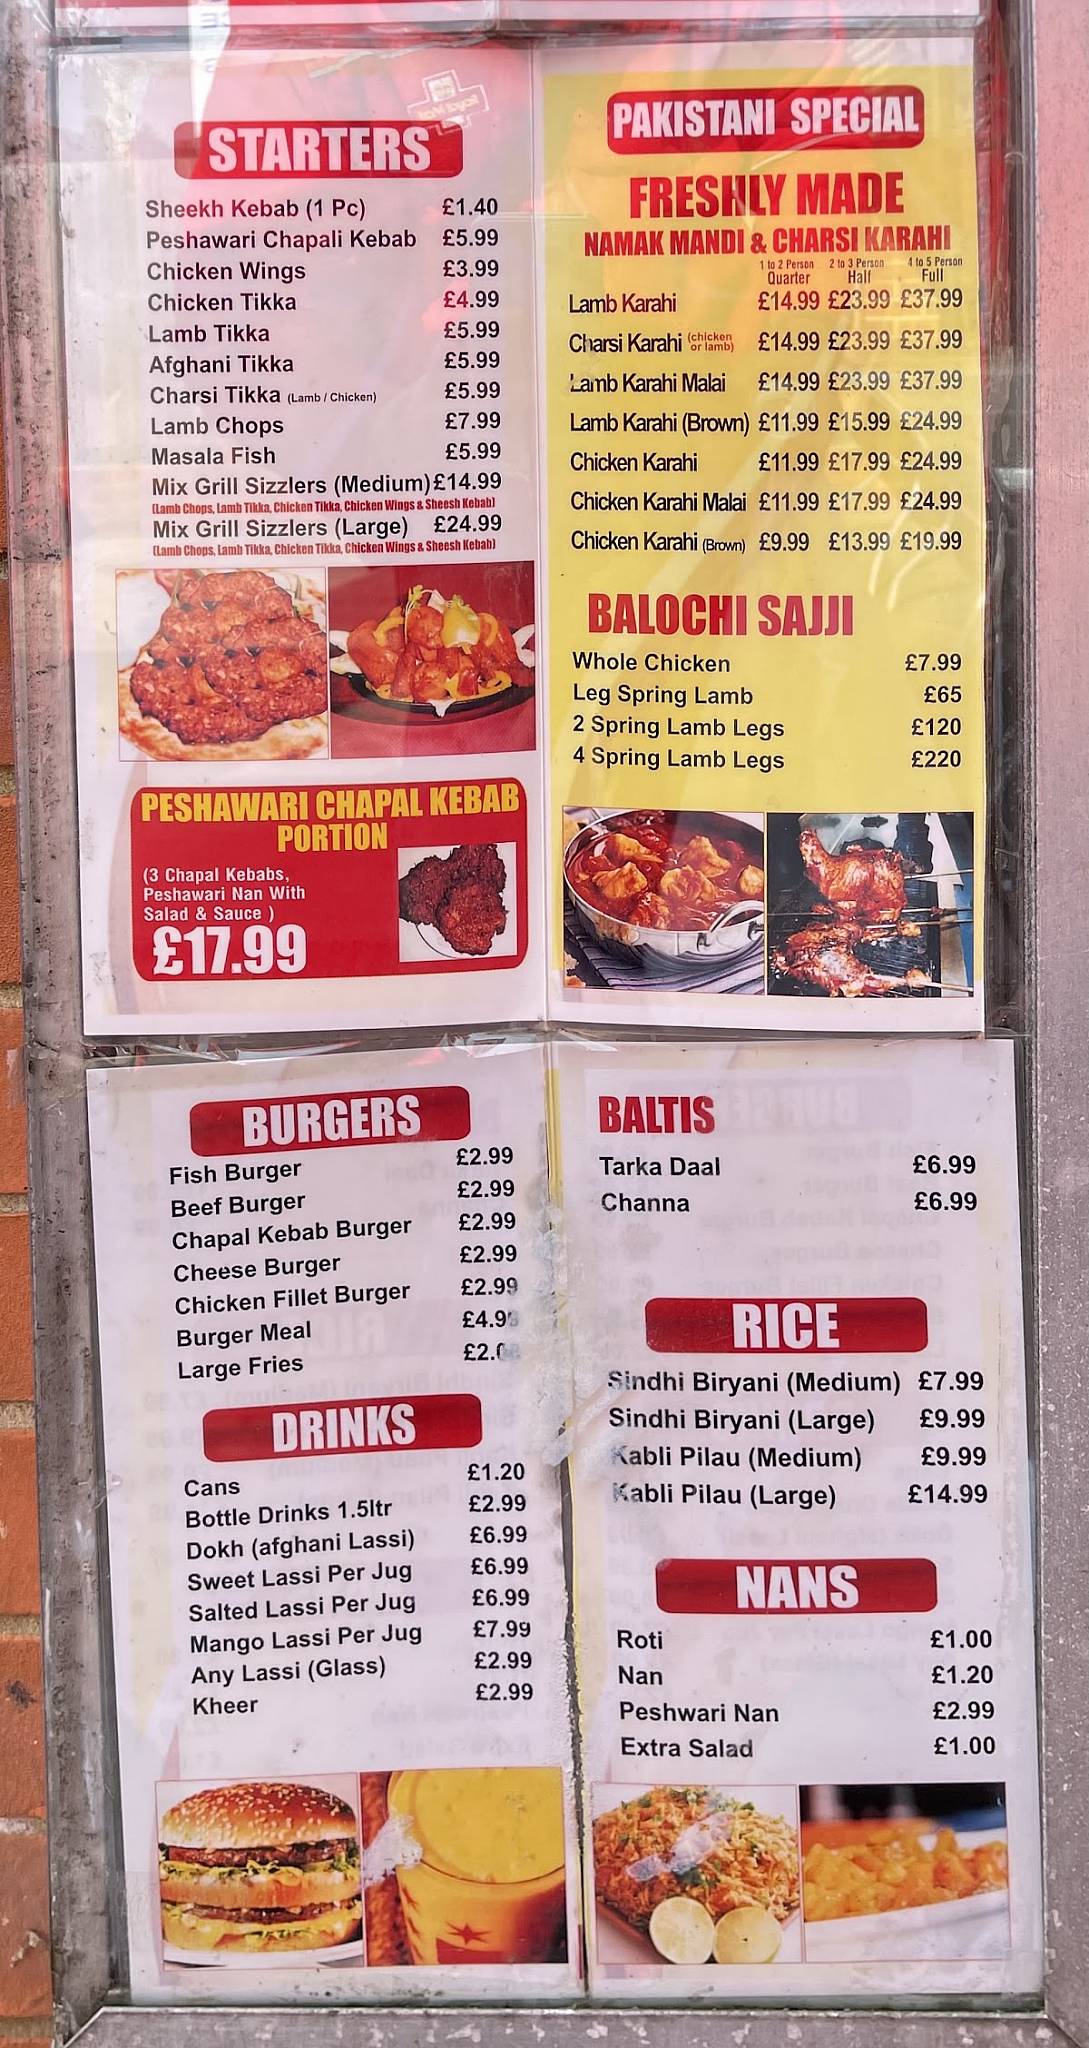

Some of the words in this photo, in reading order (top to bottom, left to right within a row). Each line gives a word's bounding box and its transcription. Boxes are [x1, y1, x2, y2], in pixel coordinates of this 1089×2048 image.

[614, 99, 775, 139] PAKISTANI
[791, 96, 919, 135] SPECIAL
[209, 127, 433, 172] STARTERS
[630, 174, 787, 219] FRESHLY
[797, 172, 904, 215] MADE
[146, 200, 224, 218] Sheekh
[232, 200, 299, 218] Kebab
[307, 199, 322, 221] (1
[333, 199, 365, 221] Pc)
[442, 198, 498, 216] £1.40
[148, 231, 256, 249] Peshawari
[264, 230, 342, 253] Chapali
[351, 230, 416, 248] Kebab
[443, 229, 498, 247] £5.99
[585, 231, 664, 257] NAMAK
[670, 229, 744, 255] MANDI
[751, 233, 767, 254] &
[773, 227, 858, 254] CHARSI
[865, 226, 950, 252] KARAHI
[148, 262, 233, 280] Chicken
[240, 262, 306, 284] Wings
[443, 260, 499, 278] £3.99
[760, 260, 764, 270] 1
[768, 260, 776, 270] to
[778, 260, 783, 270] 2
[787, 260, 814, 270] Person
[830, 259, 835, 269] 2
[838, 259, 845, 269] to
[848, 258, 853, 268] 3
[856, 258, 884, 268] Person
[908, 257, 913, 267] 4
[916, 258, 924, 267] to
[927, 257, 932, 267] 5
[935, 257, 963, 267] Person
[768, 272, 810, 286] Quarter
[848, 270, 871, 284] Half
[922, 268, 943, 282] Full
[148, 294, 233, 312] Chicken
[240, 293, 296, 311] Tikka
[444, 291, 499, 308] £4.99
[570, 294, 618, 314] Lamb
[623, 293, 676, 313] Karahi
[758, 291, 820, 311] £14.99
[828, 290, 890, 310] £23.99
[901, 288, 963, 309] £37.99
[570, 334, 623, 353] Charsi
[628, 333, 682, 353] Karahi
[688, 332, 733, 344] (chicken
[705, 342, 734, 353] lamb)
[758, 332, 820, 352] £14.99
[828, 331, 890, 351] £23.99
[901, 330, 963, 350] £37.99
[150, 356, 231, 378] Afghani
[238, 355, 294, 373] Tikka
[445, 351, 500, 369] £5.99
[151, 386, 217, 404] Charsi
[225, 386, 281, 404] Tikka
[288, 393, 321, 405] (Lamb
[324, 393, 328, 403] /
[330, 392, 377, 404] Chicken)
[445, 382, 501, 400] £5.99
[152, 448, 224, 465] Masala
[232, 447, 276, 464] Fish
[446, 442, 501, 460] £5.99
[153, 478, 188, 496] Mix
[196, 478, 238, 495] Grill
[246, 477, 327, 495] Sizzlers
[335, 474, 430, 498] (Medium)
[434, 472, 502, 491] £14.99
[153, 504, 181, 514] (Lamb
[183, 504, 215, 515] Chops,
[217, 503, 242, 514] Lamb
[244, 503, 272, 513] Tikka,
[274, 502, 313, 513] Chicken
[315, 501, 343, 513] Tikka,
[345, 501, 383, 512] Chicken
[385, 500, 415, 512] Wings
[417, 501, 424, 510] &
[426, 499, 461, 510] Sheesh
[463, 497, 495, 509] Kebab)
[589, 594, 747, 636] BALOCHI
[758, 595, 853, 636] SAJJI
[573, 652, 637, 671] Whole
[645, 654, 730, 673] Chicken
[906, 654, 962, 671] £7.99
[574, 684, 610, 706] Leg
[618, 685, 687, 708] Spring
[696, 687, 753, 705] Lamb
[924, 686, 962, 704] £65
[142, 792, 308, 822] PESHAWARI
[317, 788, 423, 820] CHAPAL
[430, 784, 520, 816] KEBAB
[278, 823, 388, 852] PORTION
[144, 868, 159, 885] (3
[166, 868, 219, 885] Chapal
[227, 867, 289, 883] Kebabs,
[144, 887, 225, 902] Peshawari
[233, 887, 263, 901] Nan
[269, 886, 305, 900] With
[144, 907, 188, 922] Salad
[196, 907, 207, 921] &
[214, 907, 261, 921] Sauce
[154, 925, 306, 976] £17.99
[244, 1095, 421, 1147] BURGERS
[599, 1096, 715, 1134] BALTIS
[170, 1166, 217, 1185] Fish
[226, 1163, 302, 1183] Burger
[456, 1147, 513, 1166] £2.99
[599, 1157, 662, 1176] Tarka
[670, 1157, 720, 1176] Daal
[913, 1155, 976, 1174] £6.99
[601, 1193, 690, 1212] Channa
[915, 1192, 977, 1211] £6.99
[176, 1295, 266, 1315] Chicken
[274, 1288, 328, 1308] Fillet
[335, 1286, 411, 1305] Burger
[461, 1278, 518, 1296] £2.99
[734, 1303, 840, 1349] RICE
[274, 1404, 416, 1452] DRINKS
[610, 1408, 685, 1429] Sindhi
[695, 1410, 780, 1435] Biryani
[789, 1409, 875, 1435] (Large)
[920, 1409, 985, 1428] £9.99
[185, 1480, 240, 1497] Cans
[468, 1463, 525, 1481] £1.20
[682, 1484, 742, 1504] Pilau
[751, 1485, 836, 1510] (Large)
[908, 1484, 988, 1504] £14.99
[186, 1508, 251, 1528] Bottle
[259, 1504, 330, 1524] Drinks
[338, 1500, 393, 1519] 1.5ltr
[469, 1494, 526, 1513] £2.99
[737, 1565, 859, 1609] NANS
[191, 1636, 264, 1656] Mango
[273, 1628, 330, 1649] Lassi
[339, 1627, 375, 1645] Per
[382, 1624, 422, 1645] Jug
[473, 1620, 531, 1638] £7.99
[618, 1630, 663, 1650] Roti
[931, 1630, 992, 1649] £1.00
[620, 1702, 726, 1722] Peshwari
[735, 1704, 779, 1722] Nan
[933, 1701, 995, 1720] £2.99
[622, 1737, 681, 1757] Extra
[689, 1739, 753, 1758] Salad
[934, 1736, 996, 1755] £1.00
